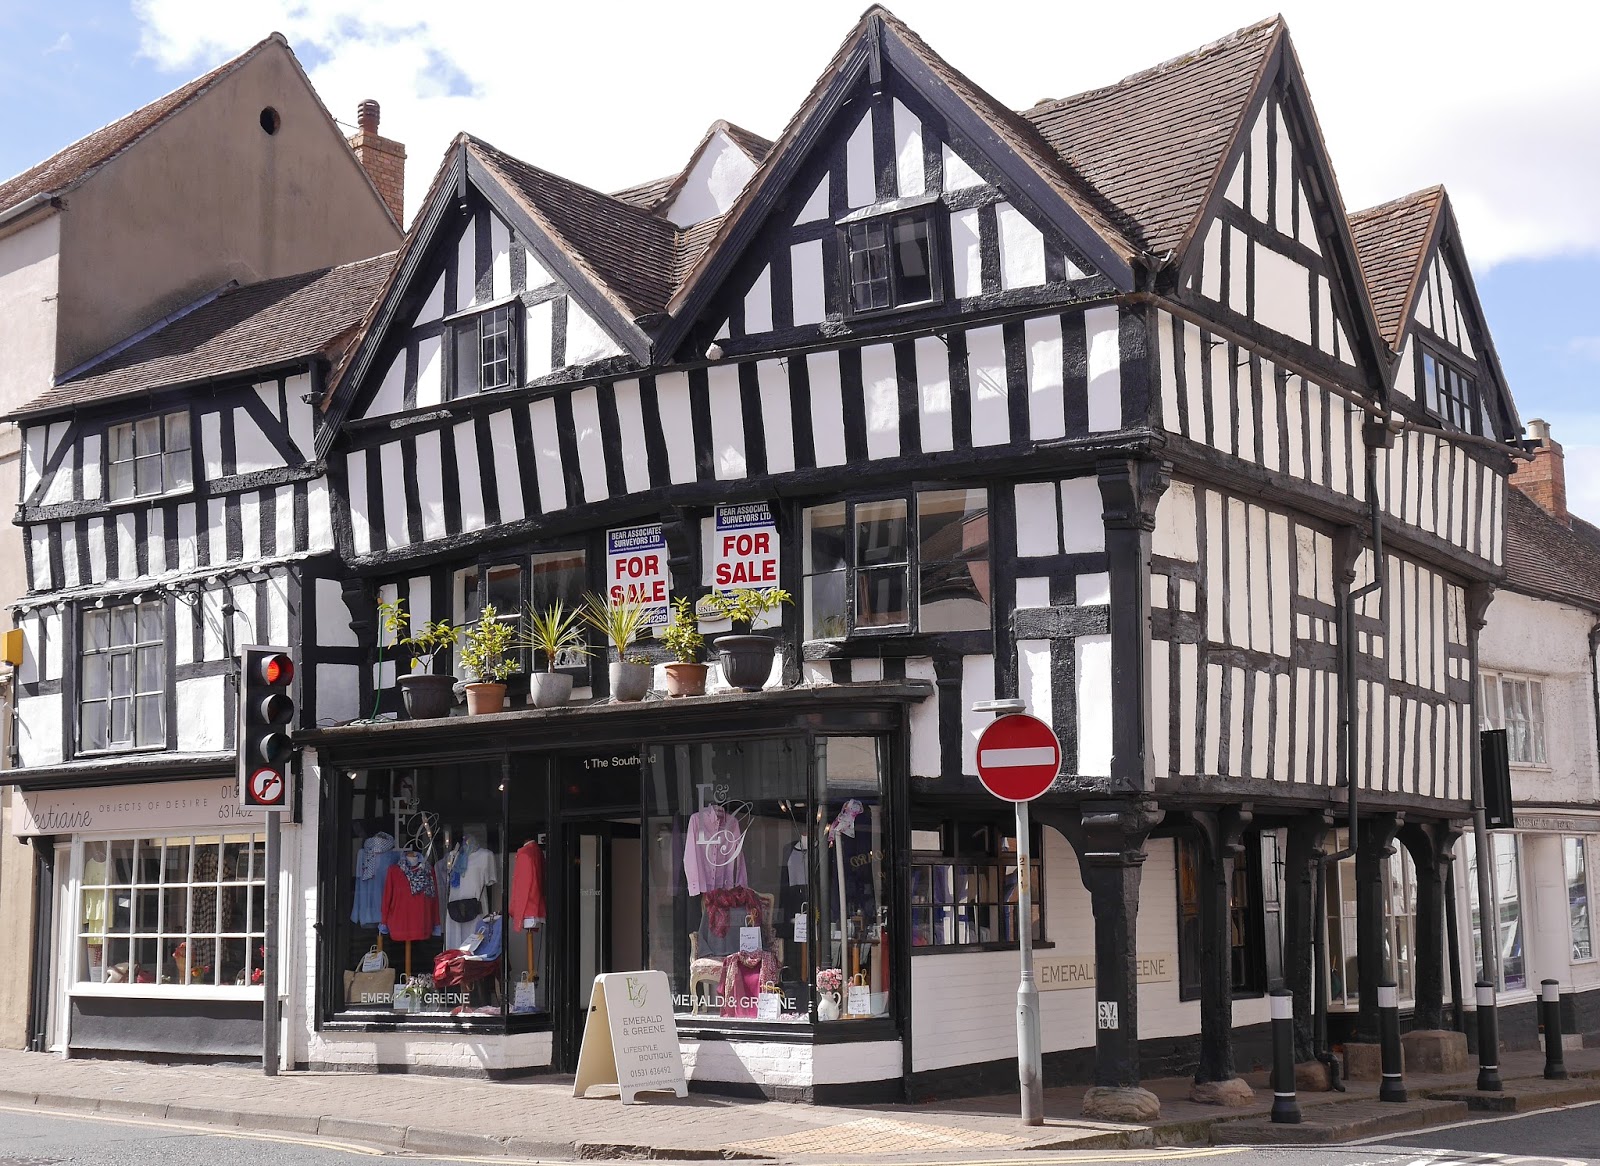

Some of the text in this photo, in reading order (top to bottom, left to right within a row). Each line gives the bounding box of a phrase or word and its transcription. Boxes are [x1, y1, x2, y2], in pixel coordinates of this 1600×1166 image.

[720, 507, 736, 517] BEAR
[722, 512, 771, 524] SURVEYORS LTD
[611, 531, 627, 540] BEAR
[614, 534, 660, 548] SURVEYORS LTD
[723, 532, 769, 557] FOR
[615, 554, 659, 580] FOR
[716, 559, 776, 585] SALE
[610, 580, 667, 607] SALE
[591, 758, 608, 768] The
[611, 753, 657, 767] Southd
[22, 794, 208, 830] Vestiaire OBJECTS OF DESIRE
[1041, 959, 1166, 983] EMERAL EENE
[424, 993, 470, 1004] GREENE
[672, 994, 724, 1008] MERALD
[727, 997, 737, 1008] &
[740, 996, 796, 1010] GRNE
[623, 1015, 663, 1026] EMERALD
[623, 1025, 665, 1036] & GREENE
[624, 1044, 658, 1054] LIFESTYLE
[639, 1051, 673, 1061] BOUTIQUE
[630, 1069, 648, 1078] 01531
